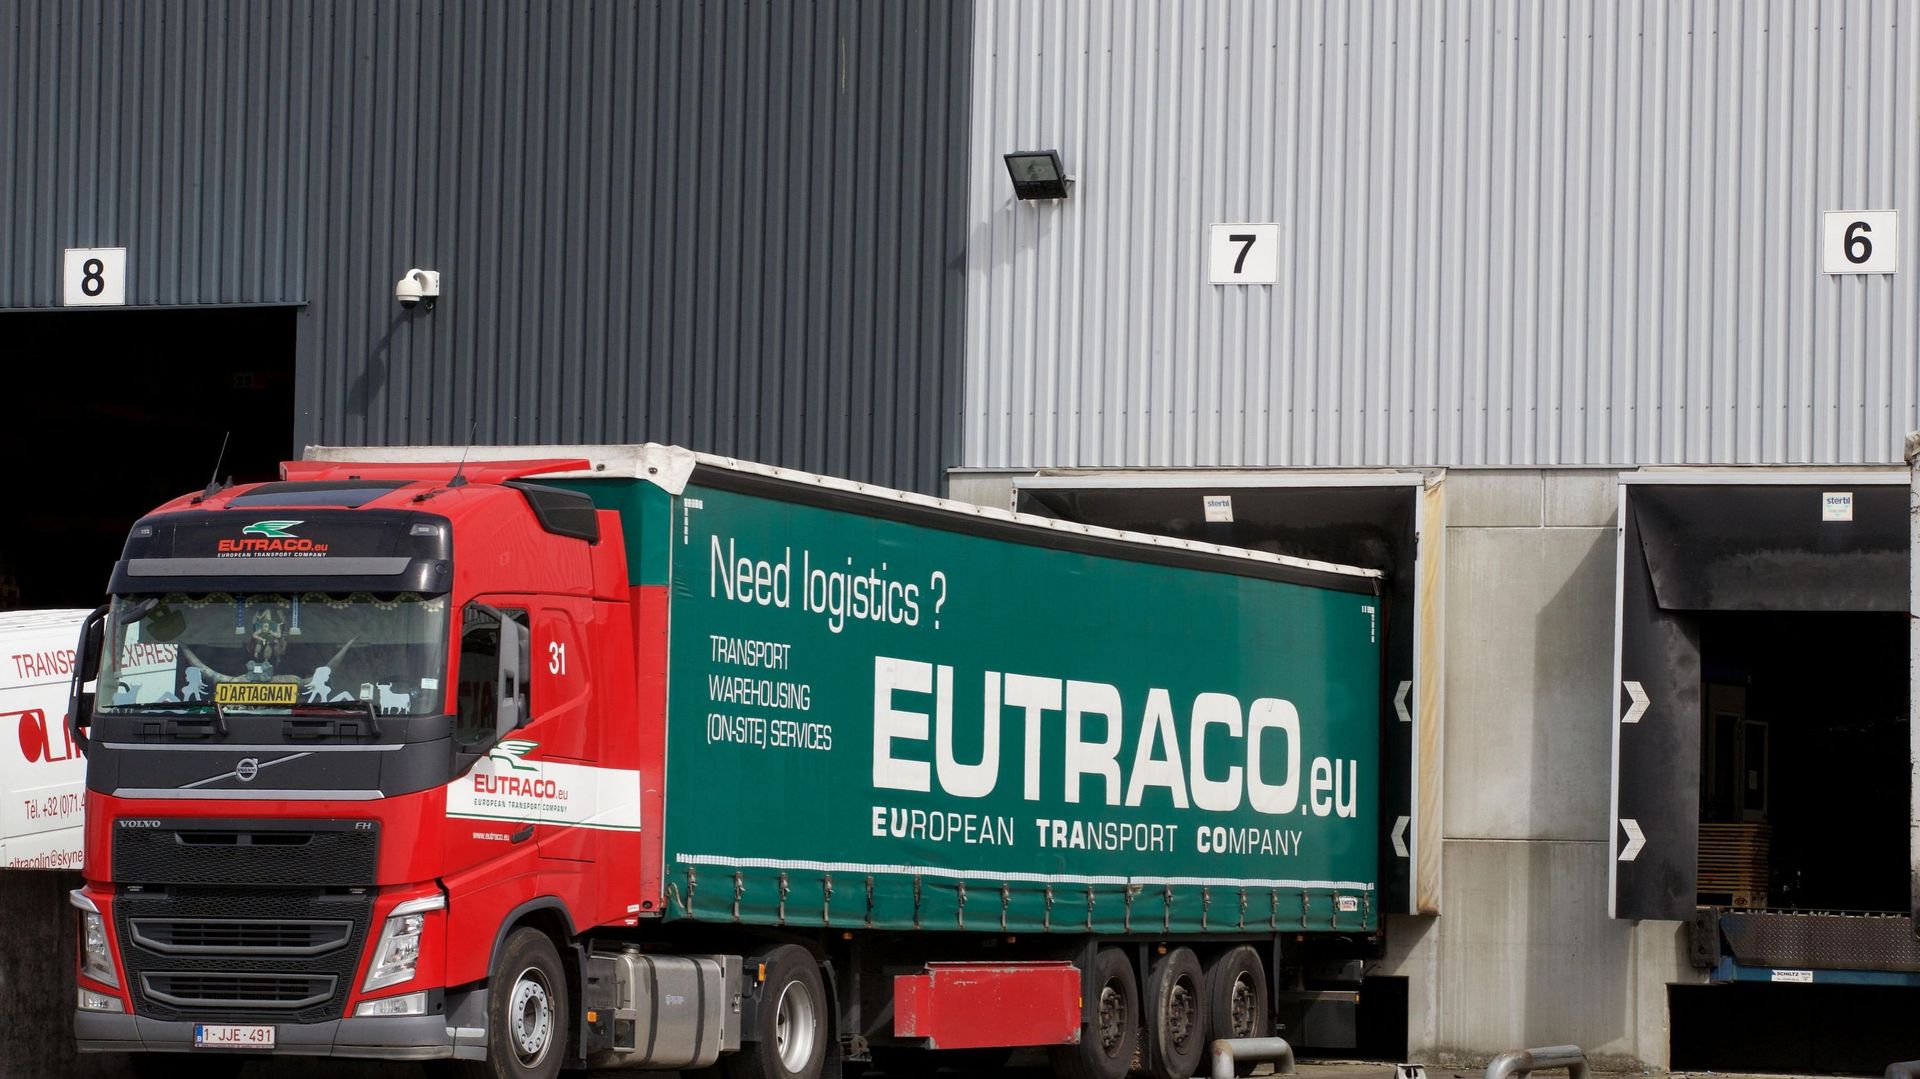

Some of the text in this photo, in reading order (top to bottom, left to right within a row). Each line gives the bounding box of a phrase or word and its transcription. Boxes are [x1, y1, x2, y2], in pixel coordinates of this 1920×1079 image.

[1229, 235, 1257, 274] 7
[1845, 222, 1873, 263] 6
[82, 258, 104, 297] 8
[710, 534, 947, 634] Need logistics ?
[549, 641, 566, 675] 31
[710, 634, 791, 670] TRANSPORT
[219, 685, 293, 702] D'ARTAGNAN
[708, 675, 811, 711] WAREHOUSING
[707, 713, 832, 751] (ON-SITE) SERVICES
[873, 655, 1357, 818] EUTRACO.eu
[25, 799, 41, 820] Tél.
[43, 796, 58, 817] +32
[474, 798, 568, 813] EUROPEAN TRANSPORT COMPANY
[119, 820, 161, 828] VOLVO
[355, 822, 372, 830] FH
[872, 806, 1303, 857] EUROPEAN TRANSPORT COMPANY
